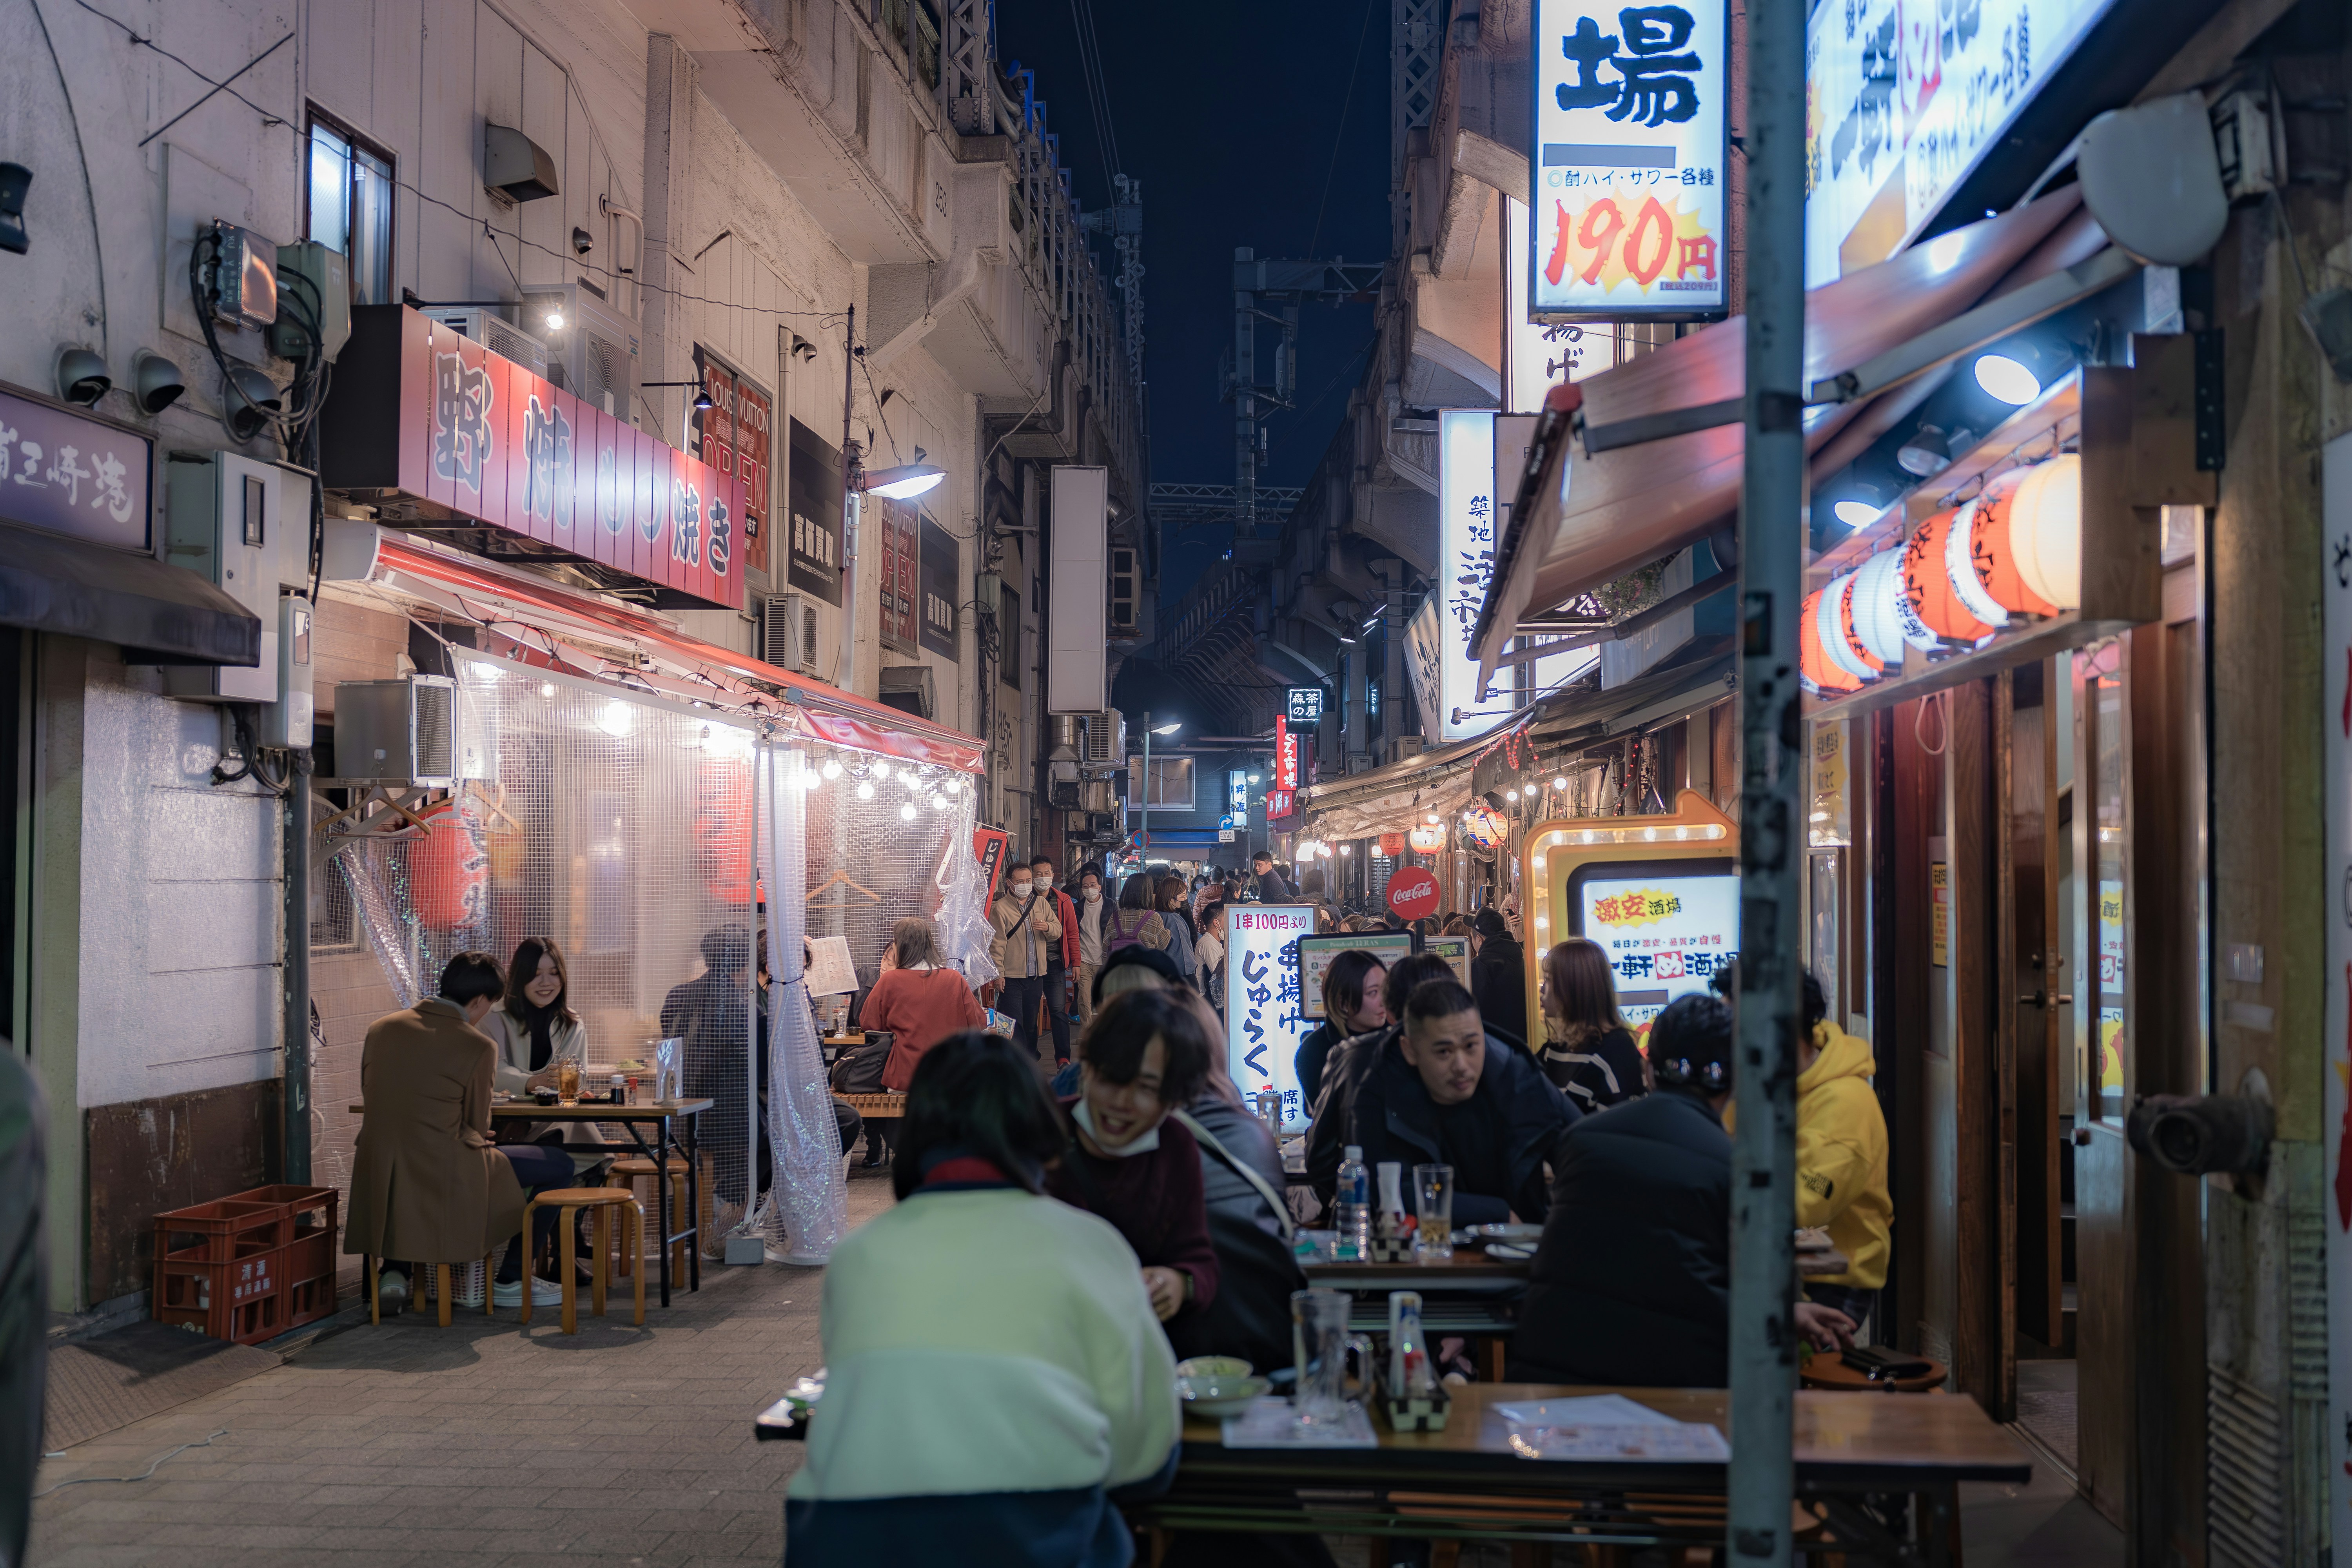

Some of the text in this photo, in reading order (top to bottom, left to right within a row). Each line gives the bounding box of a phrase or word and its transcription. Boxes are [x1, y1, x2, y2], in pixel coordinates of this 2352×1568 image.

[1556, 5, 1703, 128] 場
[935, 181, 947, 218] 253
[1544, 196, 1717, 285] 190円
[711, 378, 769, 436] LOUIS VUITTON
[703, 433, 767, 514] OPEN
[882, 501, 916, 537] LOUIS VUITTON
[1468, 495, 1493, 542] 築地
[794, 513, 834, 568] 高価買取
[927, 592, 952, 632] 高価買取
[1292, 693, 1305, 715] 森の
[1305, 693, 1319, 717] 茶屋
[1282, 718, 1297, 788] ぐろ市場
[983, 842, 998, 879] じゅら
[1235, 913, 1307, 931] 1串100円より
[1595, 894, 1681, 922] 激安酒場
[1243, 950, 1272, 1077] じゅらく
[1244, 1089, 1298, 1104] 二席
